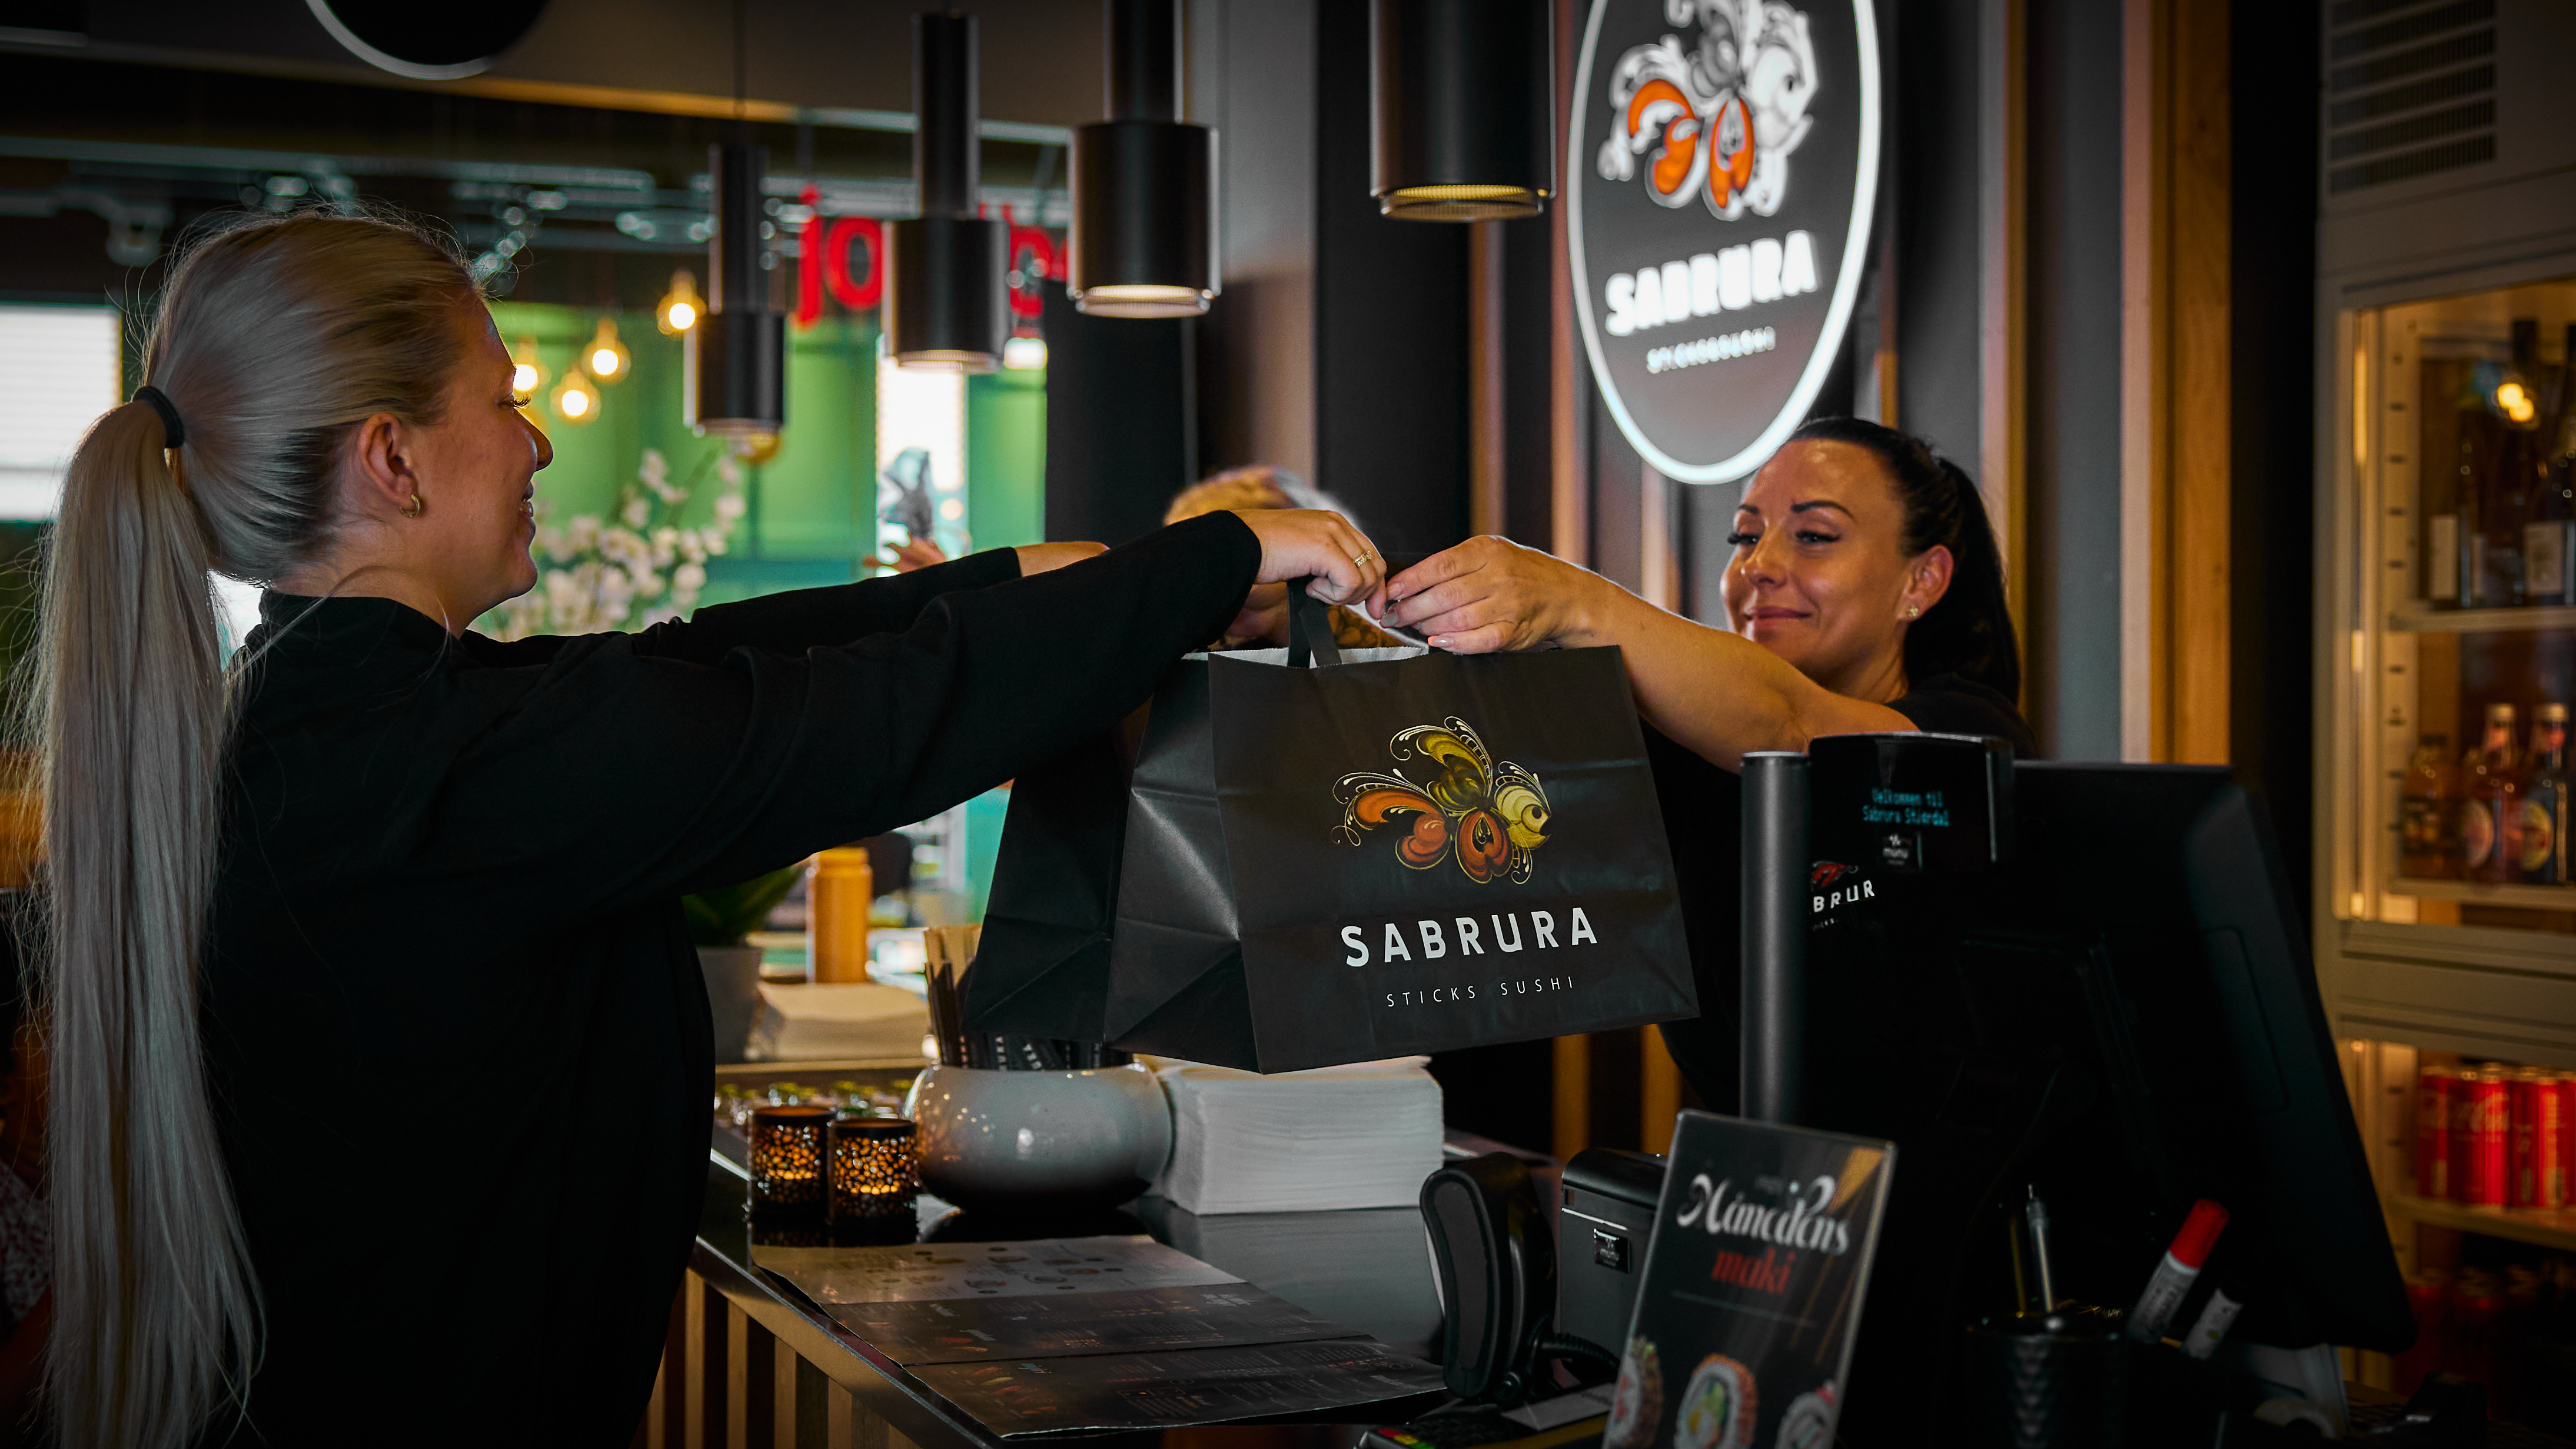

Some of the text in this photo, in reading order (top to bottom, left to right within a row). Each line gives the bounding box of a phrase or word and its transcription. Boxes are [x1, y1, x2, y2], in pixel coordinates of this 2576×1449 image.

[1606, 230, 1817, 335] SABRURA
[1813, 879, 1875, 913] BRUR
[1341, 907, 1597, 967] SABRURA
[1387, 976, 1573, 1007] STICKS SUSHI
[1711, 1247, 1796, 1295] maki
